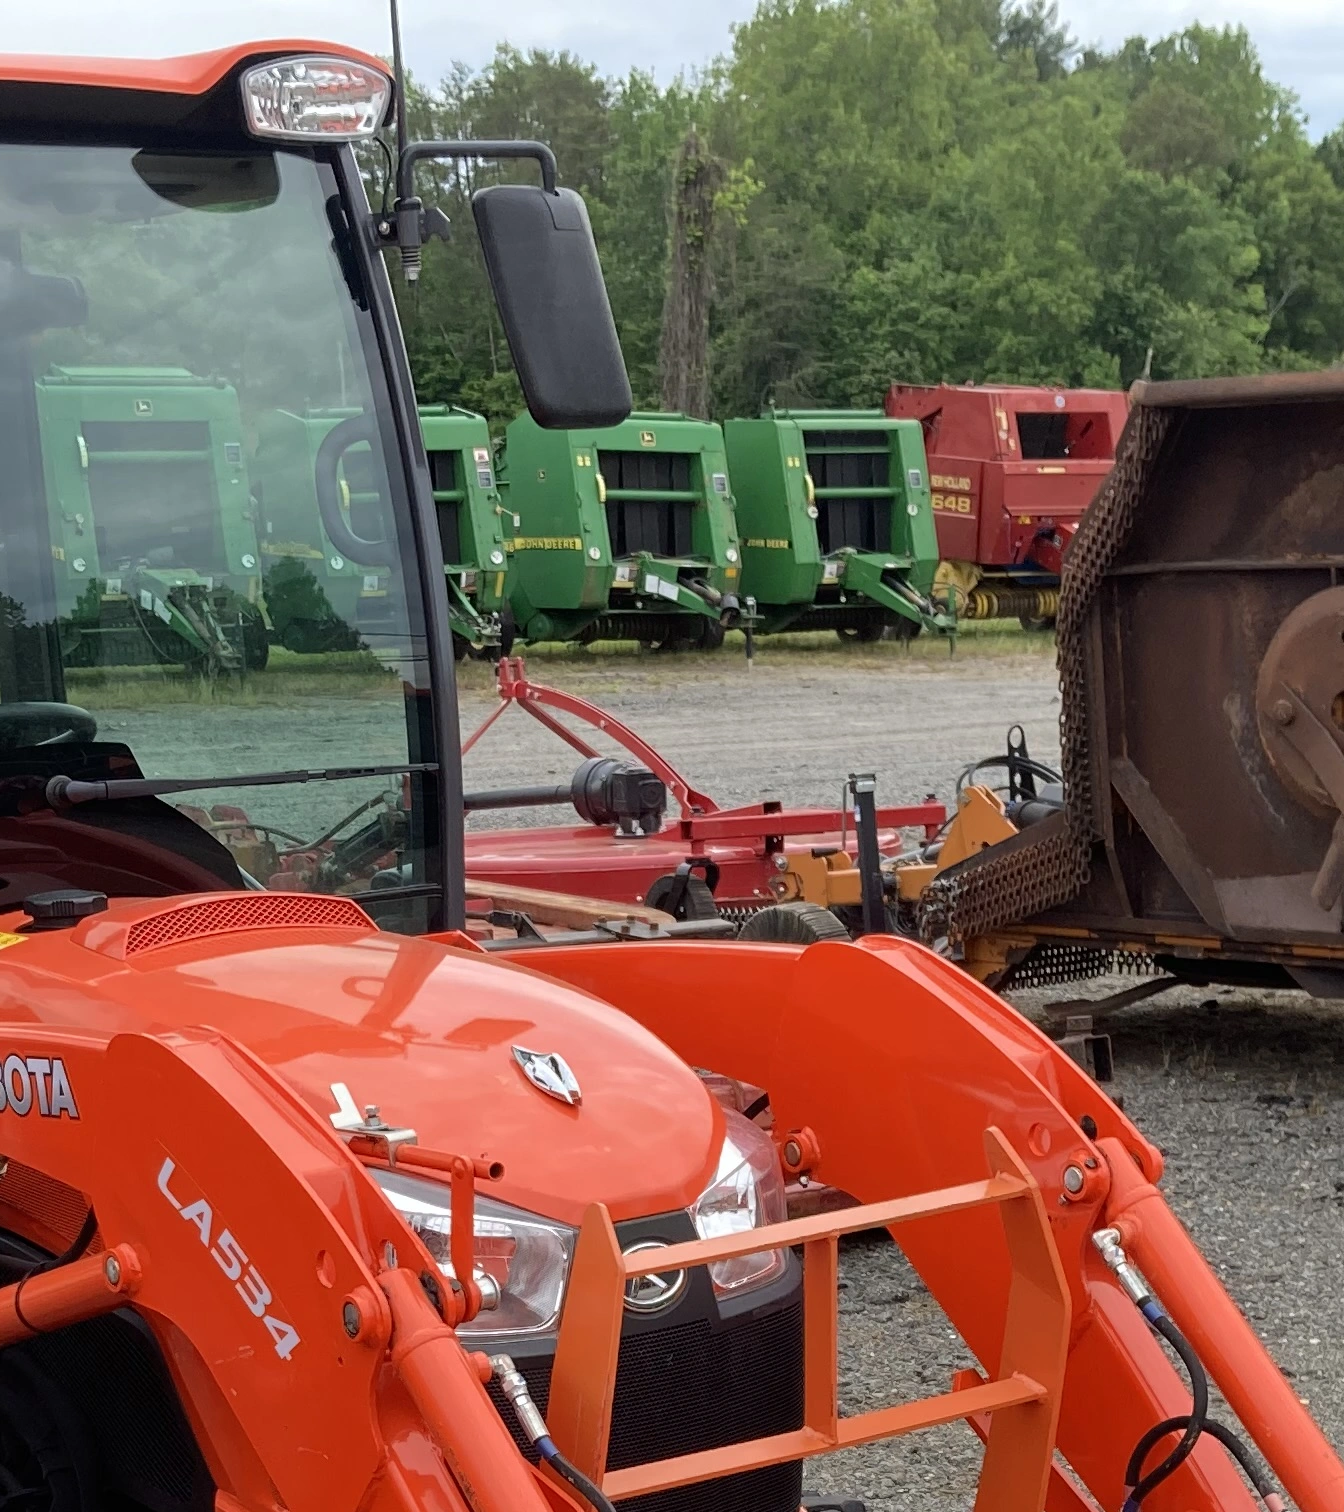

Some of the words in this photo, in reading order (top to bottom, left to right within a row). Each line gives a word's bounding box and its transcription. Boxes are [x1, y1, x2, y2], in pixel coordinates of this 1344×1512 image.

[931, 495, 970, 512] 648
[545, 539, 575, 549] DEERE
[158, 1156, 301, 1361] LA534
